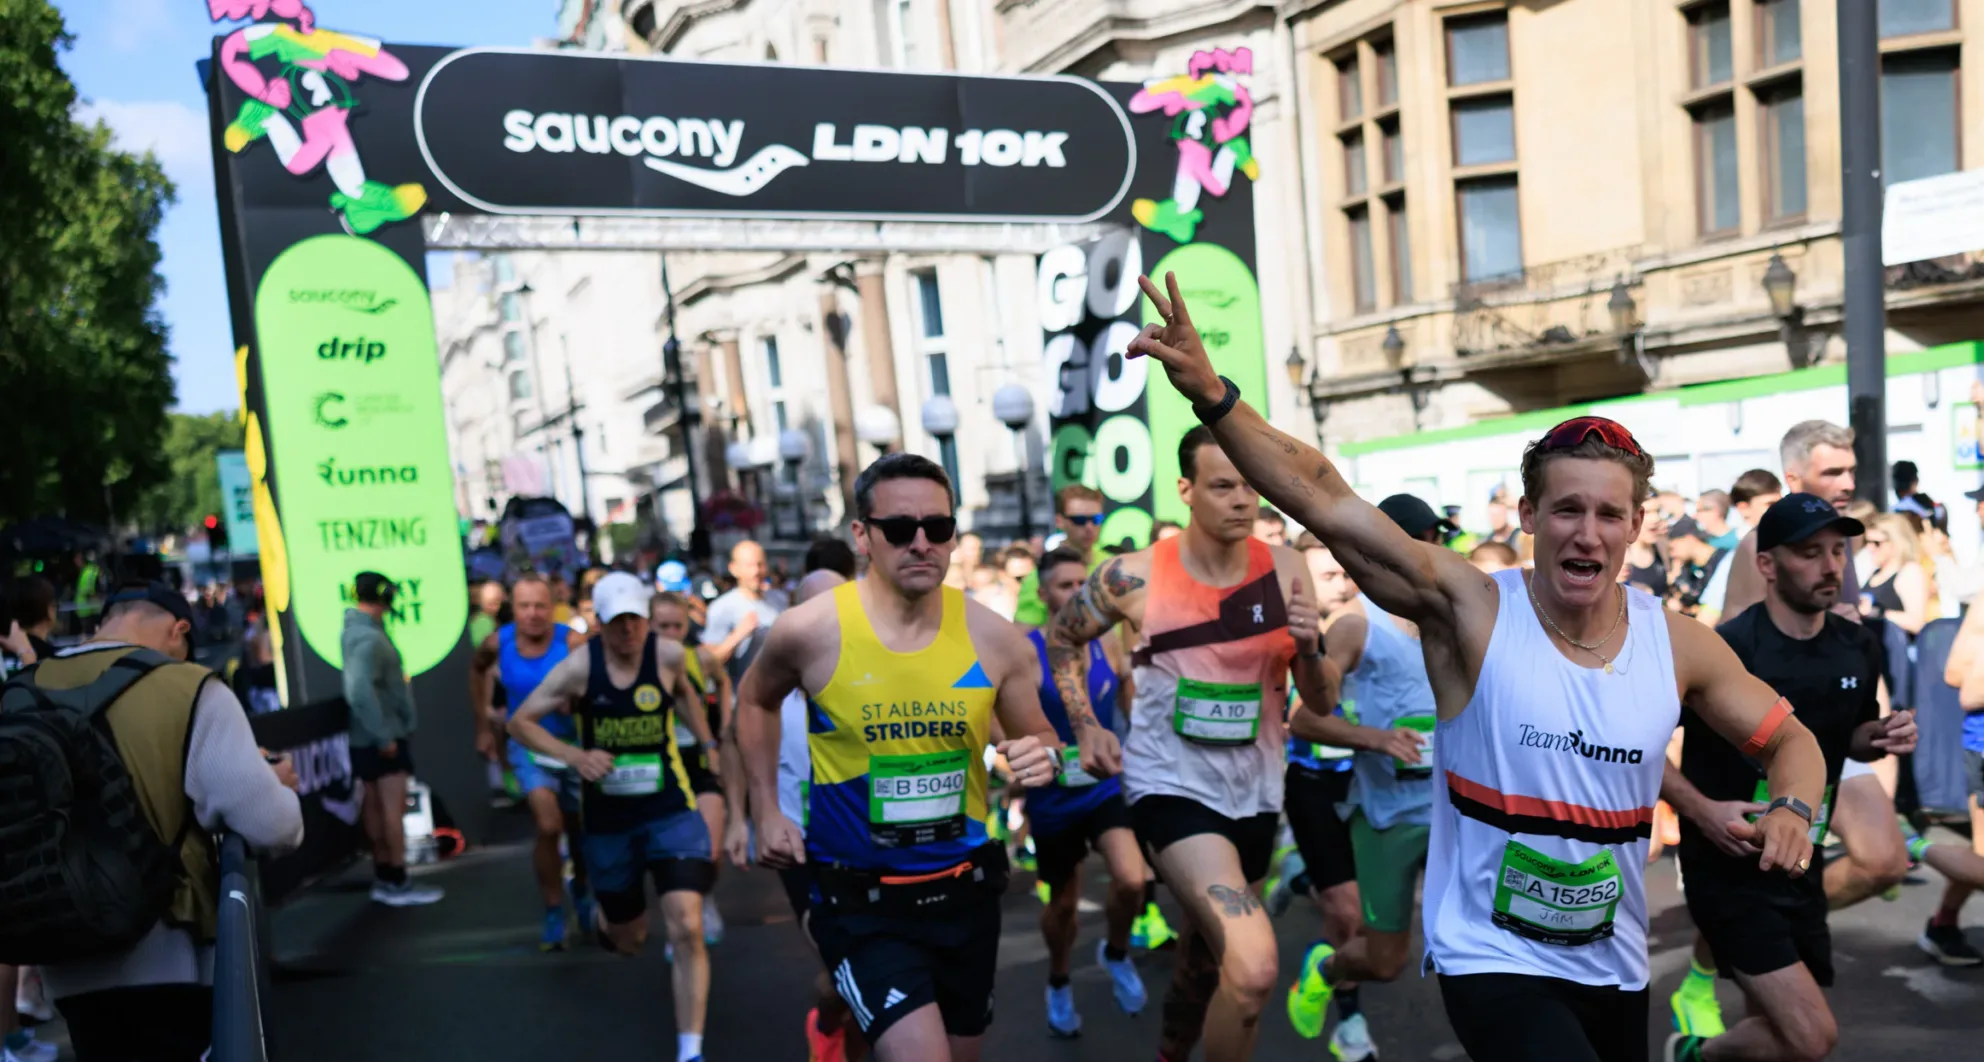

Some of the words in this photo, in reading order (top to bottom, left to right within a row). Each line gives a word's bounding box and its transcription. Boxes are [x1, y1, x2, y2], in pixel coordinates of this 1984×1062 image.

[503, 109, 745, 168] saucony
[812, 123, 948, 164] LDN
[954, 129, 1069, 168] 10K
[1038, 230, 1143, 332] GO
[317, 337, 386, 364] drip
[1043, 321, 1148, 418] GO
[317, 456, 418, 487] Runna
[1052, 414, 1155, 503] GO
[318, 516, 427, 552] TENZING
[862, 703, 882, 721] ST
[888, 700, 967, 718] ALBANS
[1210, 703, 1223, 717] A
[1228, 704, 1245, 718] 10
[863, 720, 968, 742] STRIDERS
[896, 779, 911, 796] B
[916, 773, 964, 794] 5040
[1569, 865, 1596, 877] LDN
[1527, 880, 1545, 898] A
[1550, 881, 1617, 905] 15252
[1539, 907, 1574, 926] JAM
